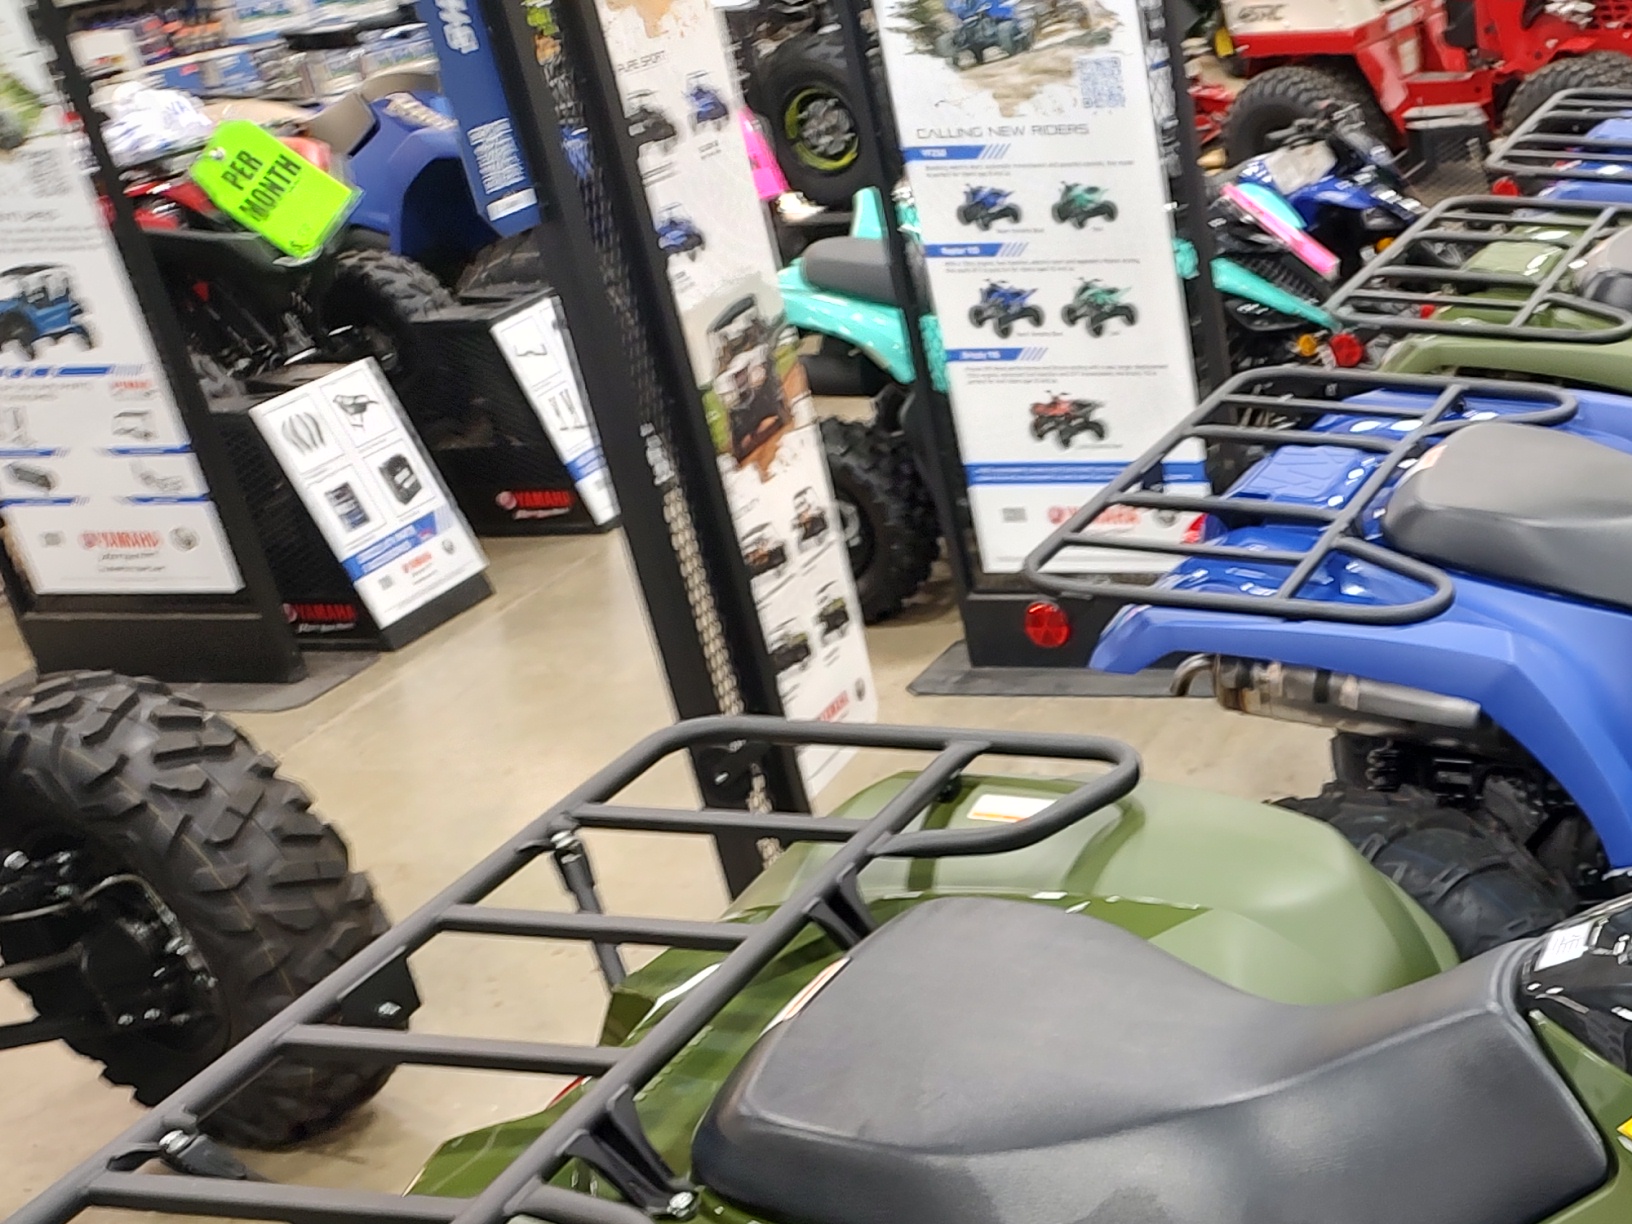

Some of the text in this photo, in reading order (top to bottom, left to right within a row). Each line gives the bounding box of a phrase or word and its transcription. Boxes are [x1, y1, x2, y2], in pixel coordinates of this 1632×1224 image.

[917, 123, 1089, 139] CALLING NEW RIDERS
[221, 150, 263, 191] PER
[239, 153, 302, 222] MONTH
